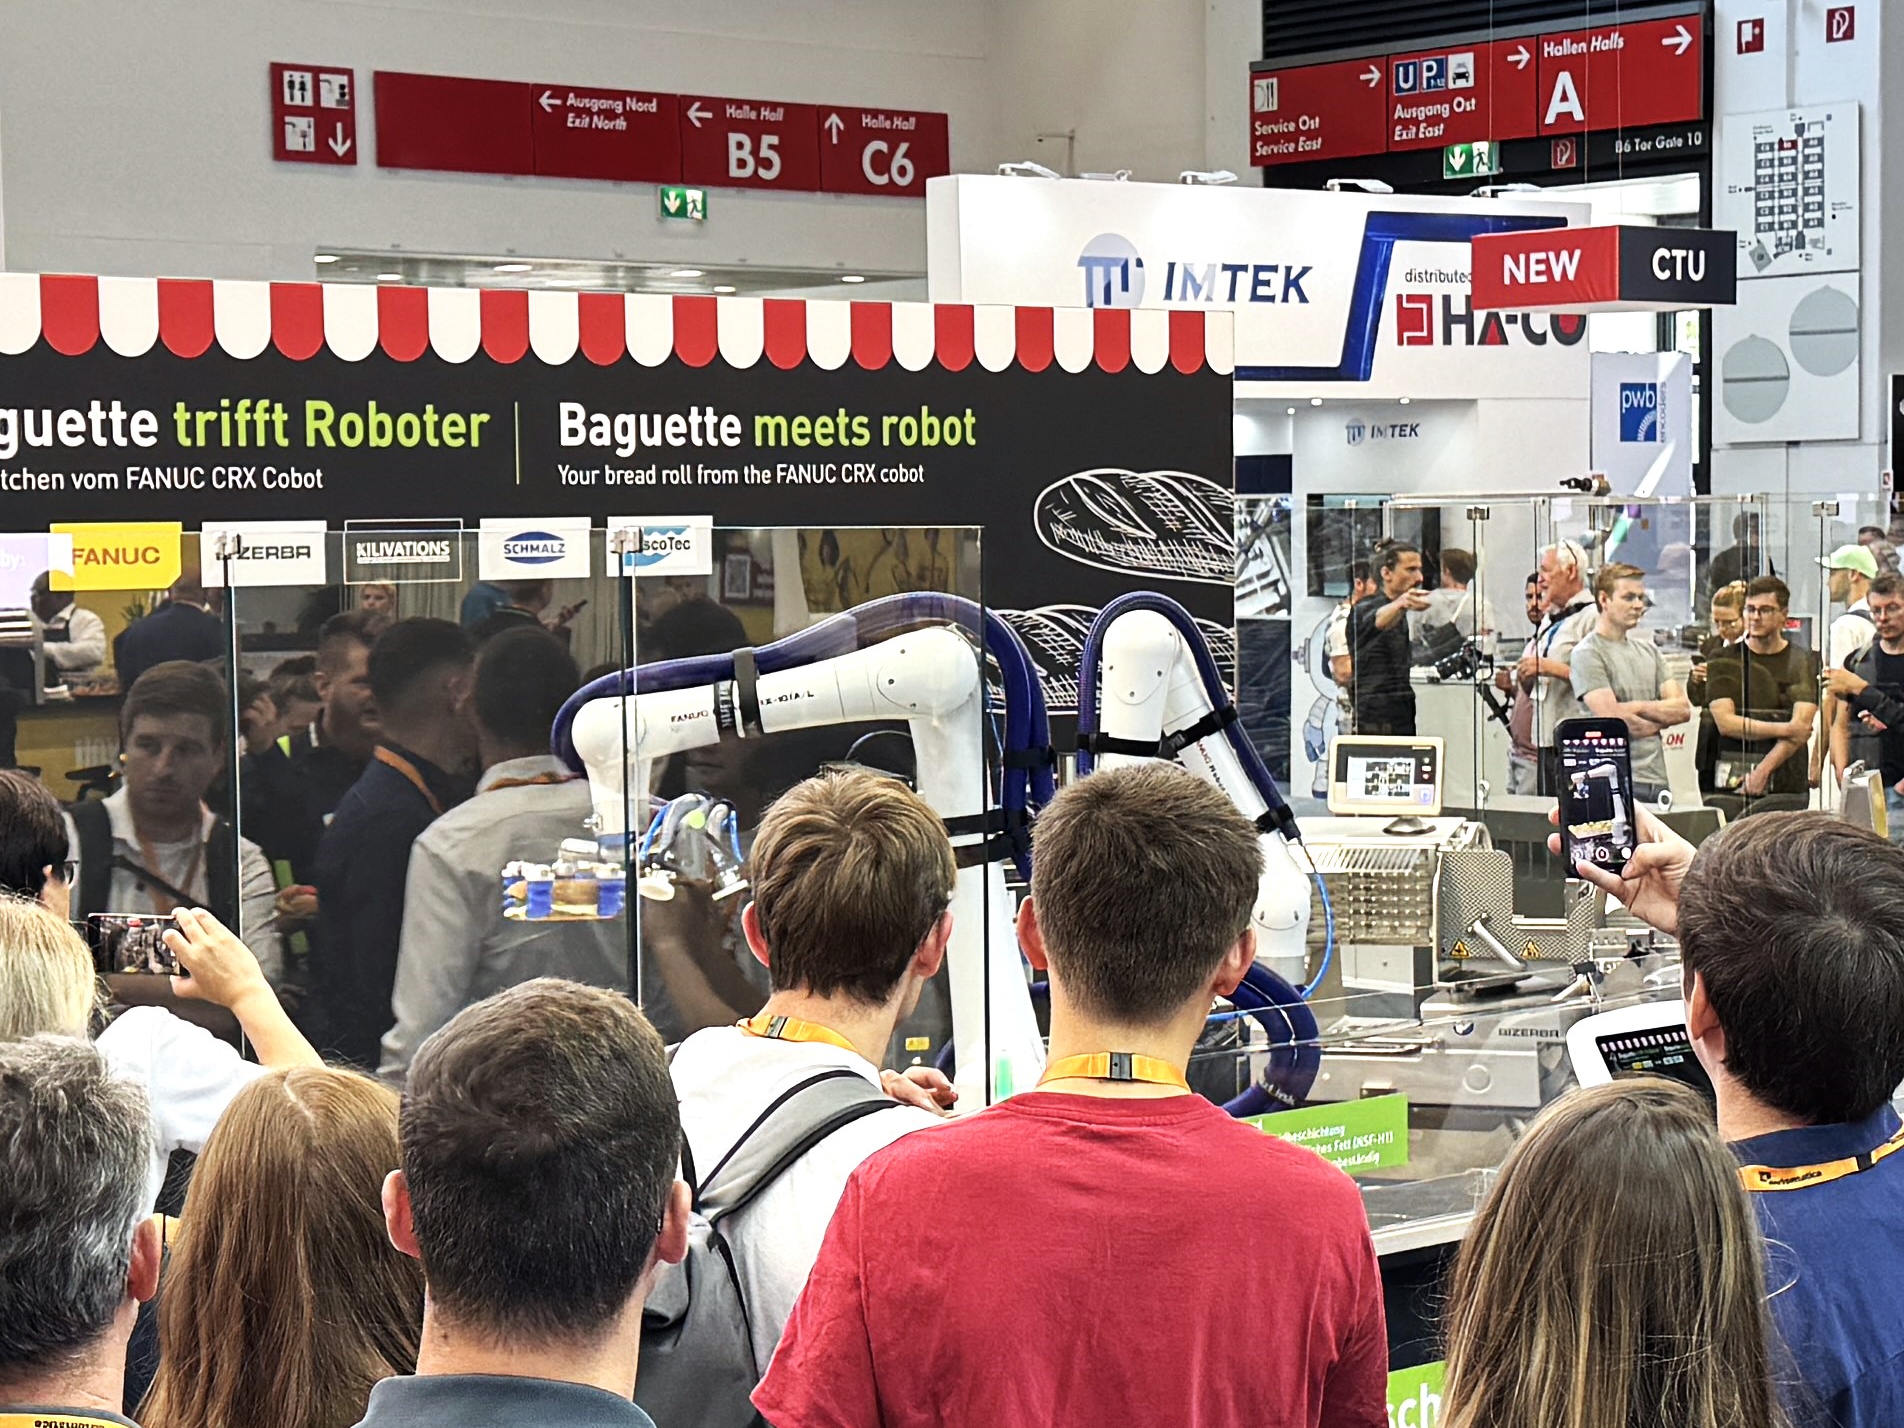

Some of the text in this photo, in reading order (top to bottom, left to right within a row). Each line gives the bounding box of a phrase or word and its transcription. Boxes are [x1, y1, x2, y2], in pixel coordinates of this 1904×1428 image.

[1544, 34, 1625, 58] Hallen Halls
[1399, 64, 1414, 89] U
[1423, 60, 1437, 89] P
[567, 93, 657, 113] Ausgang Nord
[1394, 97, 1476, 121] Ausgang Ost
[1544, 71, 1584, 125] A
[567, 113, 627, 131] Exit North
[726, 104, 784, 122] Halle Hall
[862, 113, 915, 131] Halle Hall
[1255, 115, 1320, 137] Service Ost
[1394, 122, 1444, 141] Exit East
[1255, 136, 1322, 158] Service East
[1634, 137, 1652, 152] Tor
[1655, 135, 1683, 150] Gate
[1687, 132, 1702, 147] 10
[728, 132, 781, 180] B5
[861, 140, 915, 187] C6
[1503, 249, 1582, 285] NEW
[1652, 247, 1705, 282] CTU
[1162, 261, 1313, 304] IMTEK
[1622, 383, 1655, 414] pwb
[172, 400, 290, 448] trifft
[305, 402, 490, 448] Roboter
[558, 402, 977, 457] Baguette meets robot
[1371, 423, 1420, 439] IMTEK
[71, 474, 119, 491] vom
[126, 467, 205, 490] FANUC
[211, 467, 256, 490] CRX
[262, 467, 324, 490] Cobot
[558, 464, 925, 485] Your bread roll from the FANUC CRX cobot
[216, 545, 311, 561] ZERBA
[356, 540, 450, 559] KILIVATIONS
[504, 542, 566, 555] SCHMALZ
[642, 536, 691, 552] scoTec
[72, 546, 160, 565] FANUC
